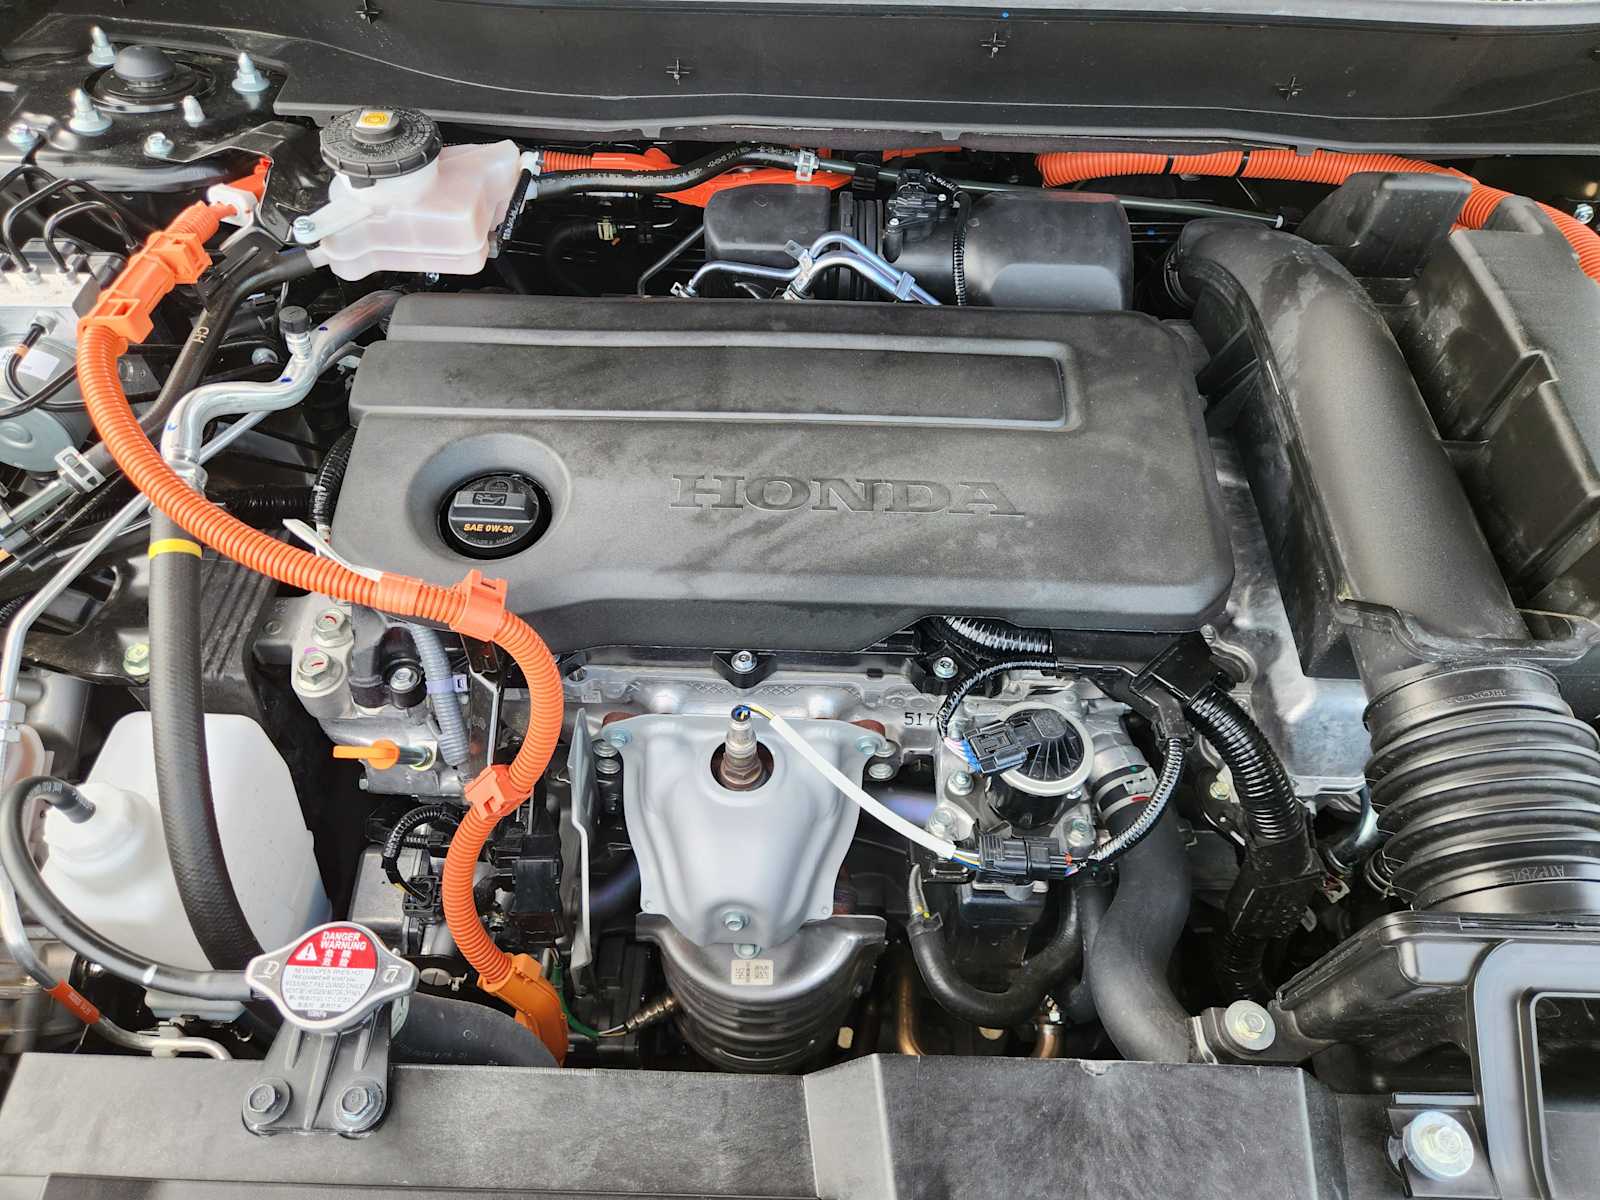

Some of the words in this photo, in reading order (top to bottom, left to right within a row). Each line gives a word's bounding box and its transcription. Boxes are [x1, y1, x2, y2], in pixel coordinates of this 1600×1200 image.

[668, 473, 1026, 518] HONDA
[463, 523, 484, 533] SAE
[485, 523, 514, 534] 0W-20
[322, 931, 361, 942] DANGER
[320, 940, 367, 951] WARNUNG
